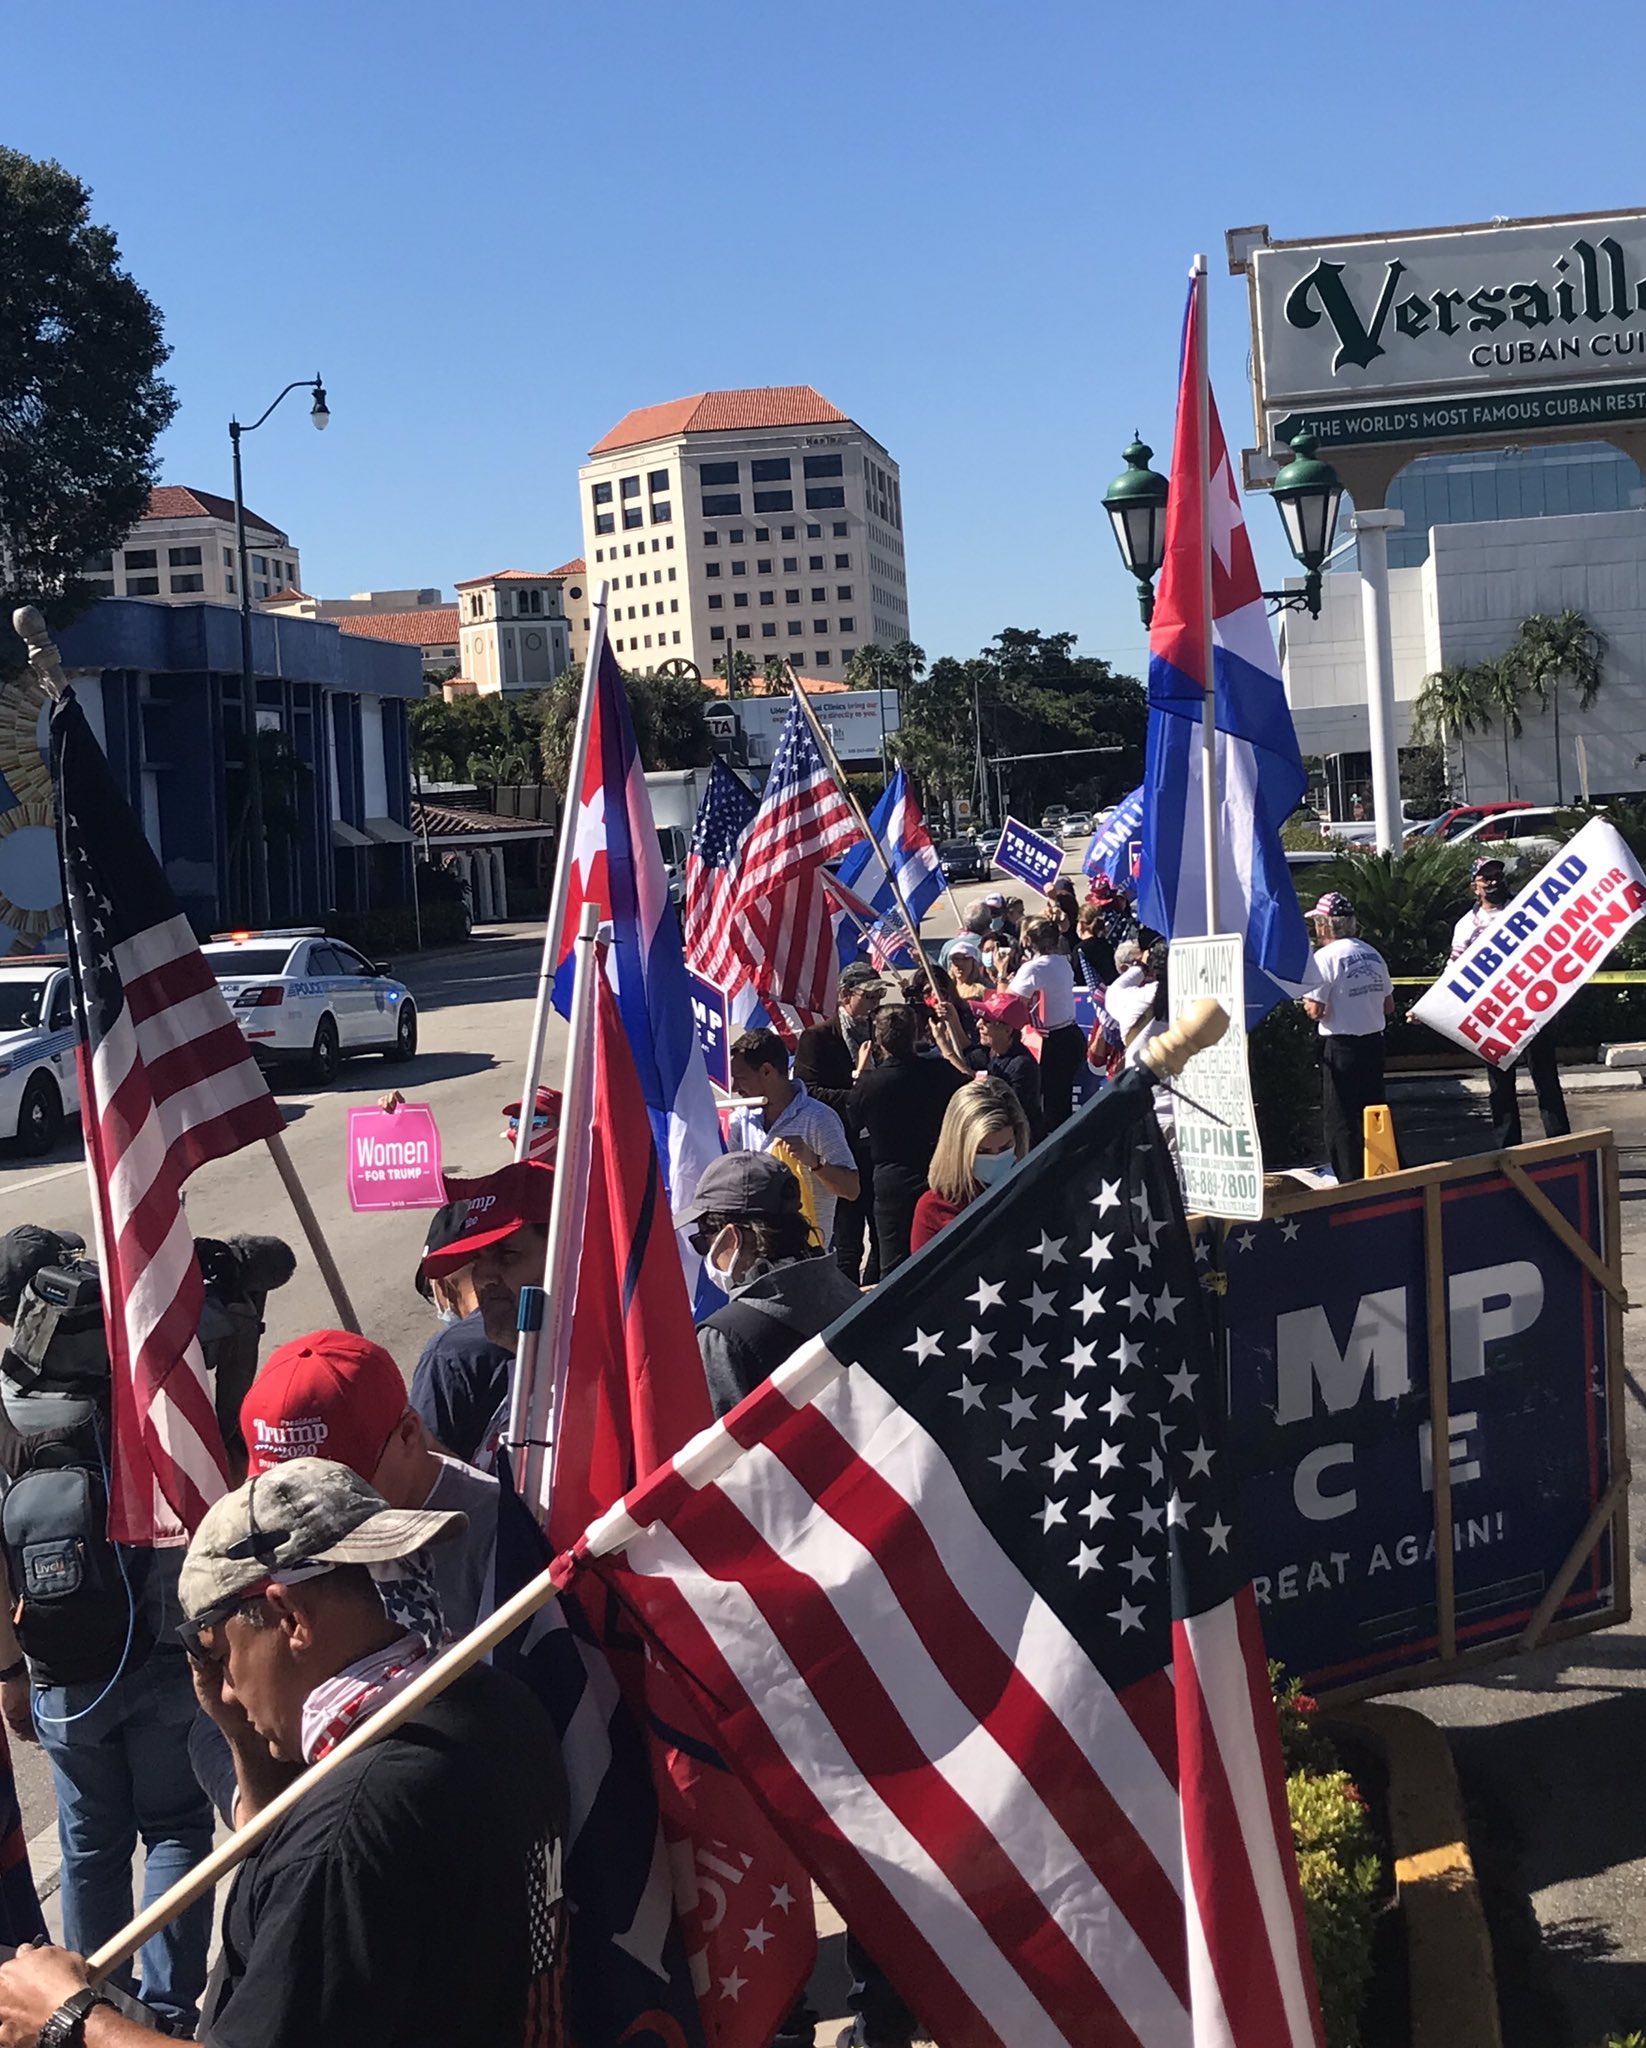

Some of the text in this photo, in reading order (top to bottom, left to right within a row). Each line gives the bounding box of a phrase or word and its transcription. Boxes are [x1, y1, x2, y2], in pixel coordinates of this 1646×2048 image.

[1285, 235, 1646, 377] Versaill
[1470, 335, 1580, 368] CUBAN
[1309, 419, 1341, 437] THE
[1344, 412, 1418, 434] WORLD'S
[1423, 408, 1467, 427] MOST
[1473, 402, 1540, 424] FAMOUS
[1545, 396, 1601, 416] CUBAN
[1006, 831, 1058, 870] TRUMP
[1007, 846, 1049, 876] PENCE
[1447, 854, 1588, 1003] LIBERTAD
[1457, 867, 1627, 1043] FREEDOM FOR
[294, 982, 324, 996] POLICE
[1478, 880, 1646, 1066] AROCENA
[357, 1136, 428, 1168] Women
[1179, 1126, 1254, 1157] ALPINE
[364, 1167, 422, 1182] FOR TRUMP
[253, 1418, 329, 1444] Trump
[278, 1444, 318, 1458] 2020
